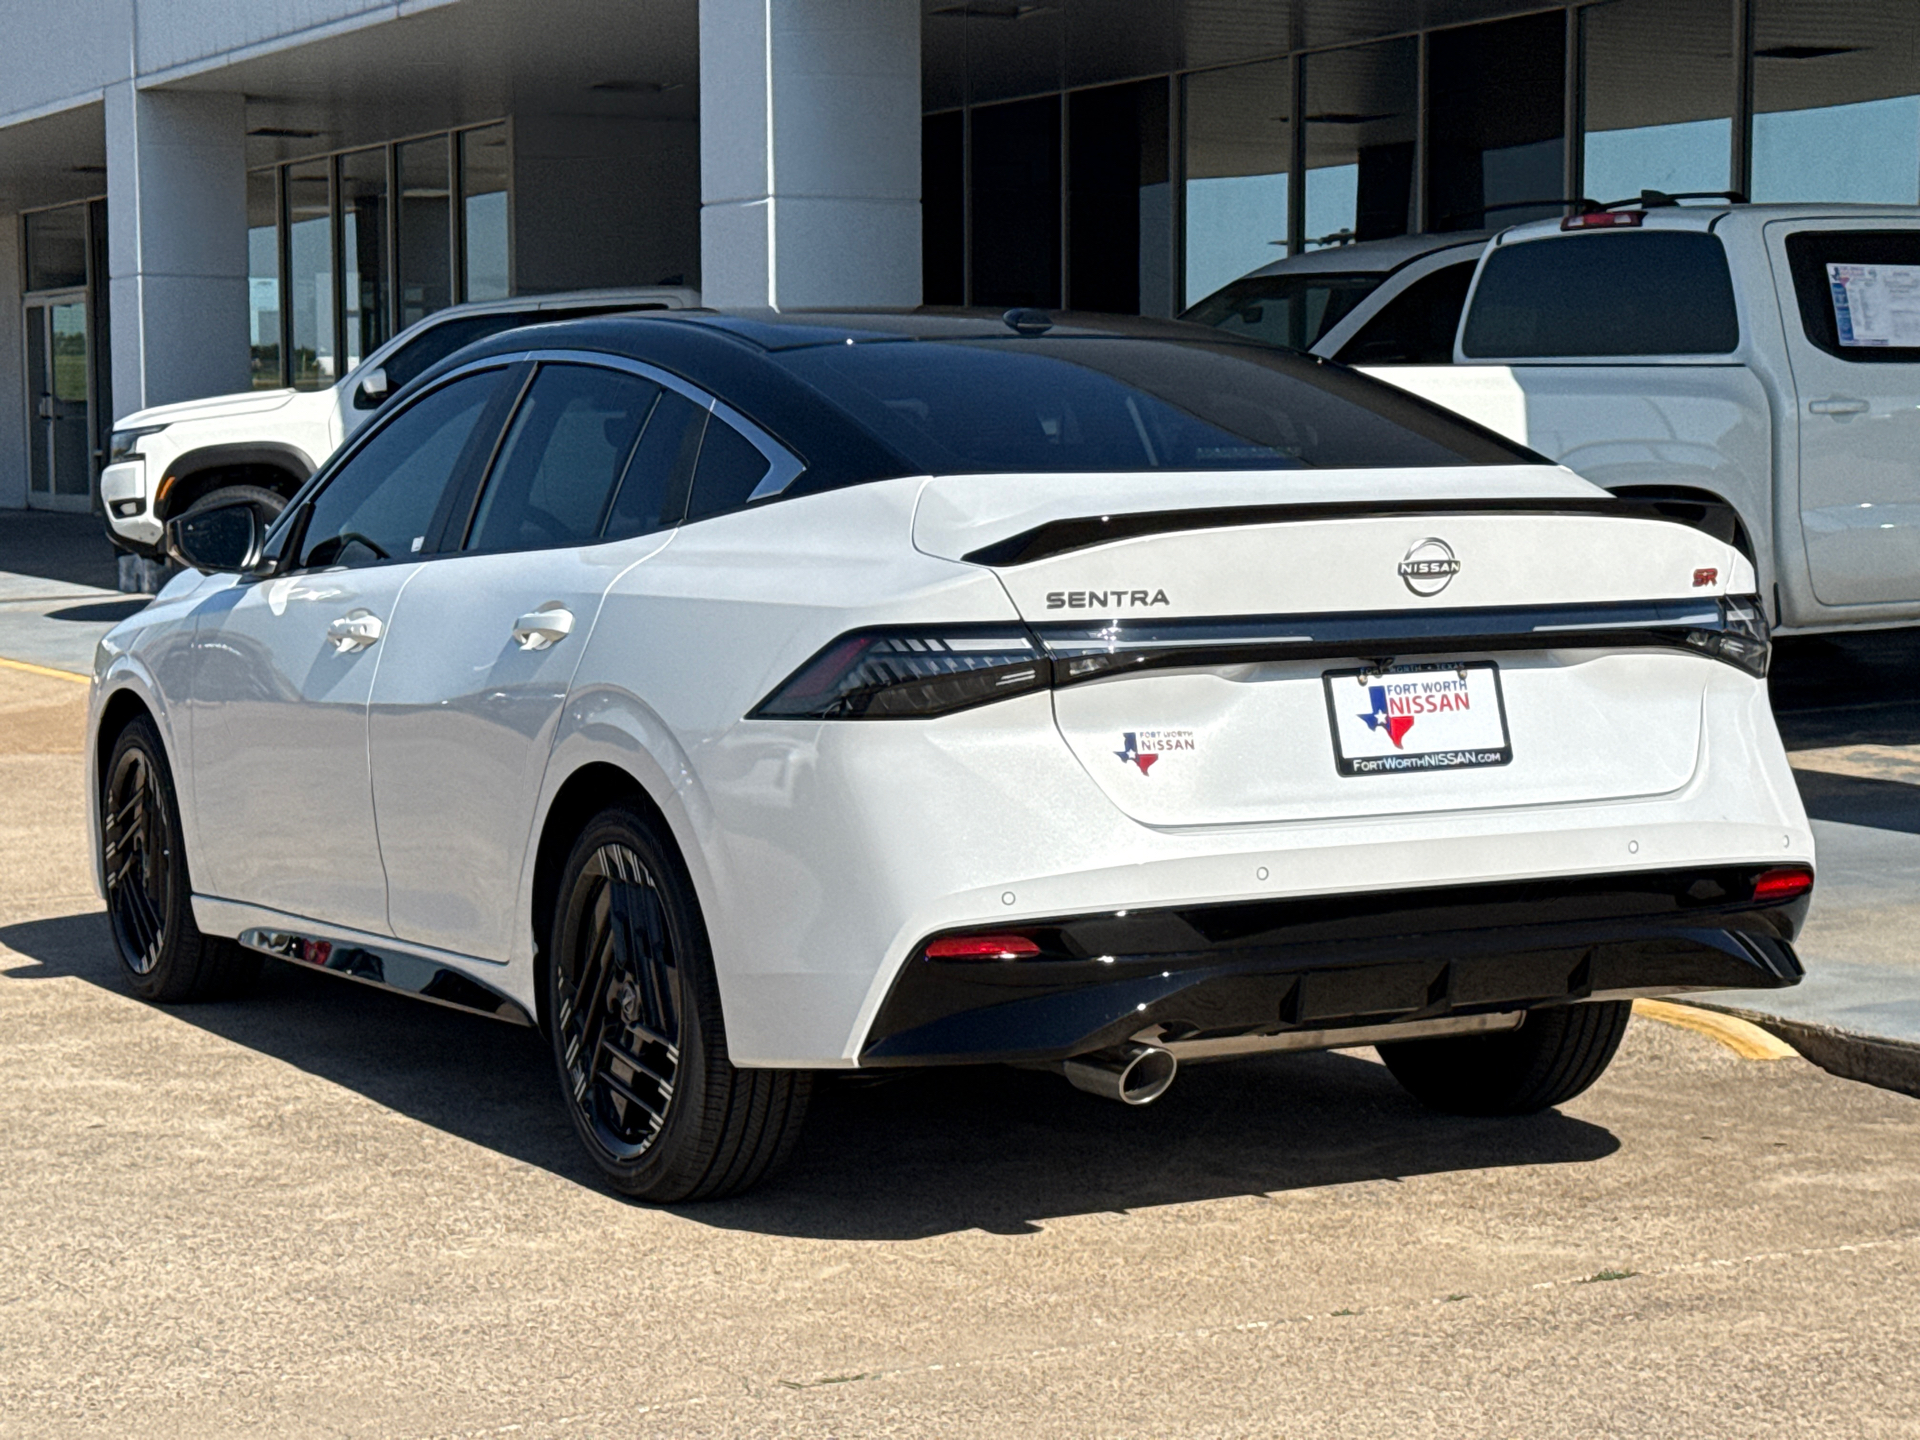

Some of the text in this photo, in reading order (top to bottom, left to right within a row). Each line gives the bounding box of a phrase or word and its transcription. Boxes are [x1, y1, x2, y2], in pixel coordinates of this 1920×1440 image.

[1400, 562, 1460, 574] NISSAN
[1692, 567, 1718, 588] SR
[1046, 588, 1170, 610] SENTRA
[1387, 680, 1467, 695] FORT WORTH
[1389, 692, 1470, 714] NISSAN
[1141, 739, 1195, 751] NISSAN
